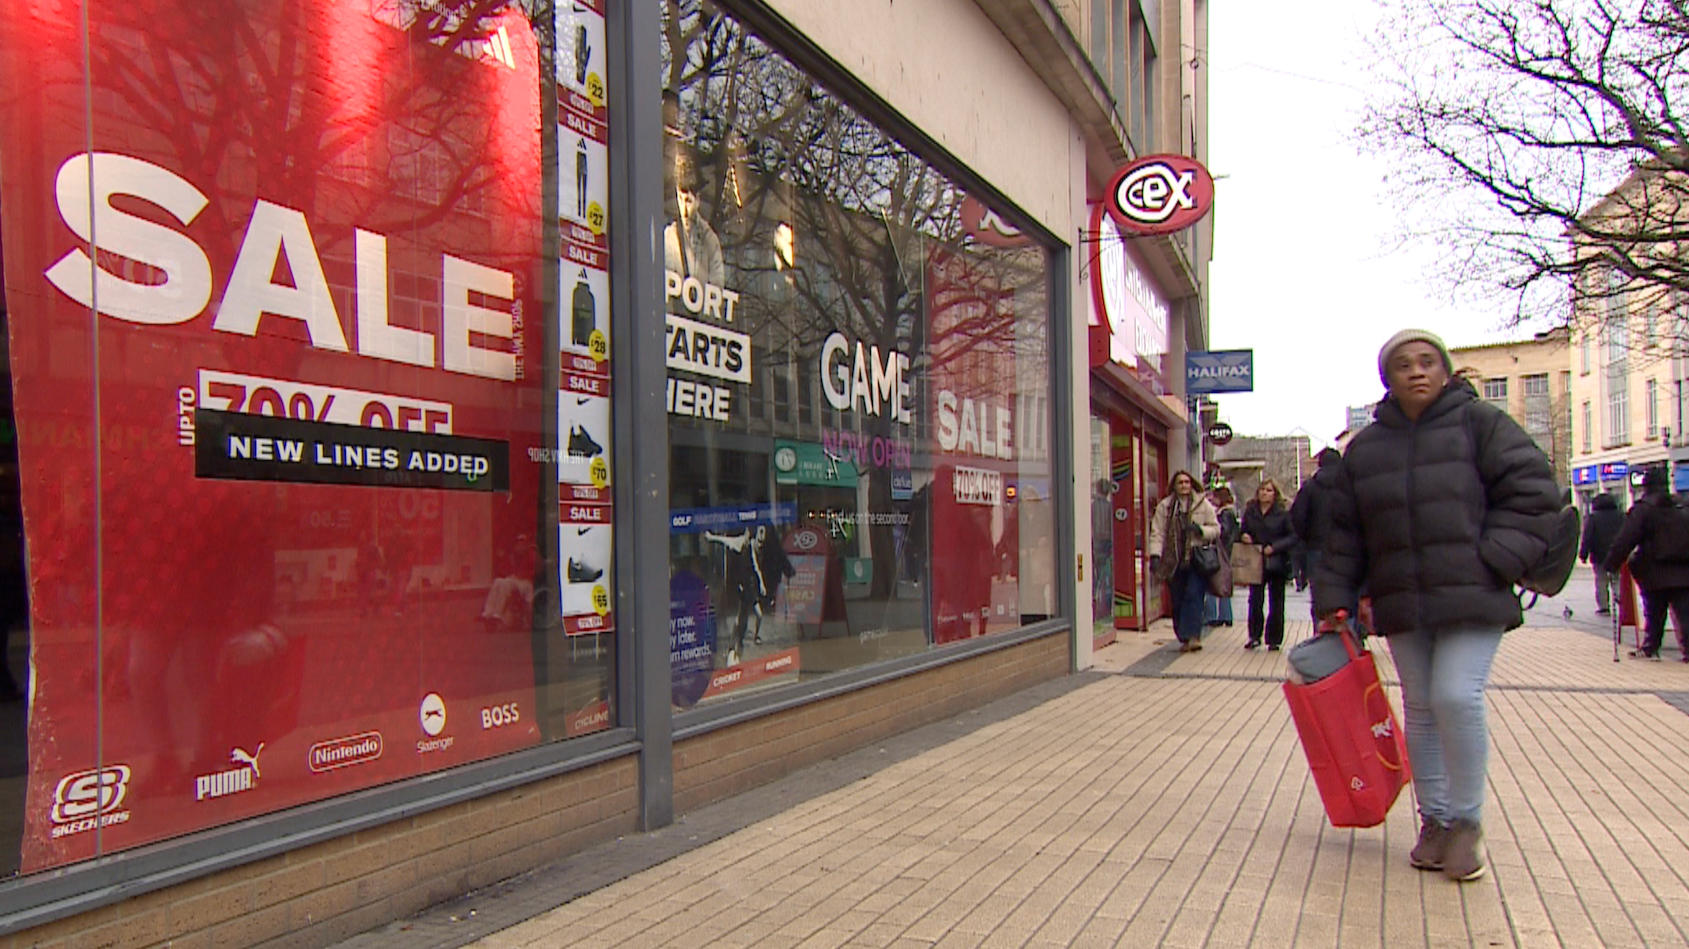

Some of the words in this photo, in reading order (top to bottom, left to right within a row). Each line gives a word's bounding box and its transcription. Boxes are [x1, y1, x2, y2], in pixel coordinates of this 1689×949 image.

[567, 113, 597, 137] SALE
[44, 152, 516, 382] SALE
[568, 245, 597, 266] SALE
[665, 269, 740, 323] PORT
[666, 326, 743, 374] ARTS
[569, 376, 600, 393] SALE
[820, 331, 911, 424] GAME
[1188, 364, 1250, 378] HALIFAX
[937, 389, 1012, 460] SALE
[1210, 428, 1231, 437] COSTA
[229, 435, 304, 462] NEW
[315, 442, 399, 469] LINES
[407, 451, 490, 475] ADDED
[823, 429, 868, 467] NOW
[872, 435, 911, 469] OPEN
[957, 470, 980, 500] 70%
[981, 473, 999, 502] OFF
[570, 507, 601, 520] SALE
[673, 515, 693, 526] GOLF
[713, 671, 742, 687] CRICKET
[766, 655, 792, 671] RUNNING
[482, 702, 519, 729] BOSS
[314, 738, 378, 764] Nintendo
[417, 737, 454, 753] Slazenger
[197, 768, 252, 800] PUMA
[52, 811, 131, 838] SKECHERS
